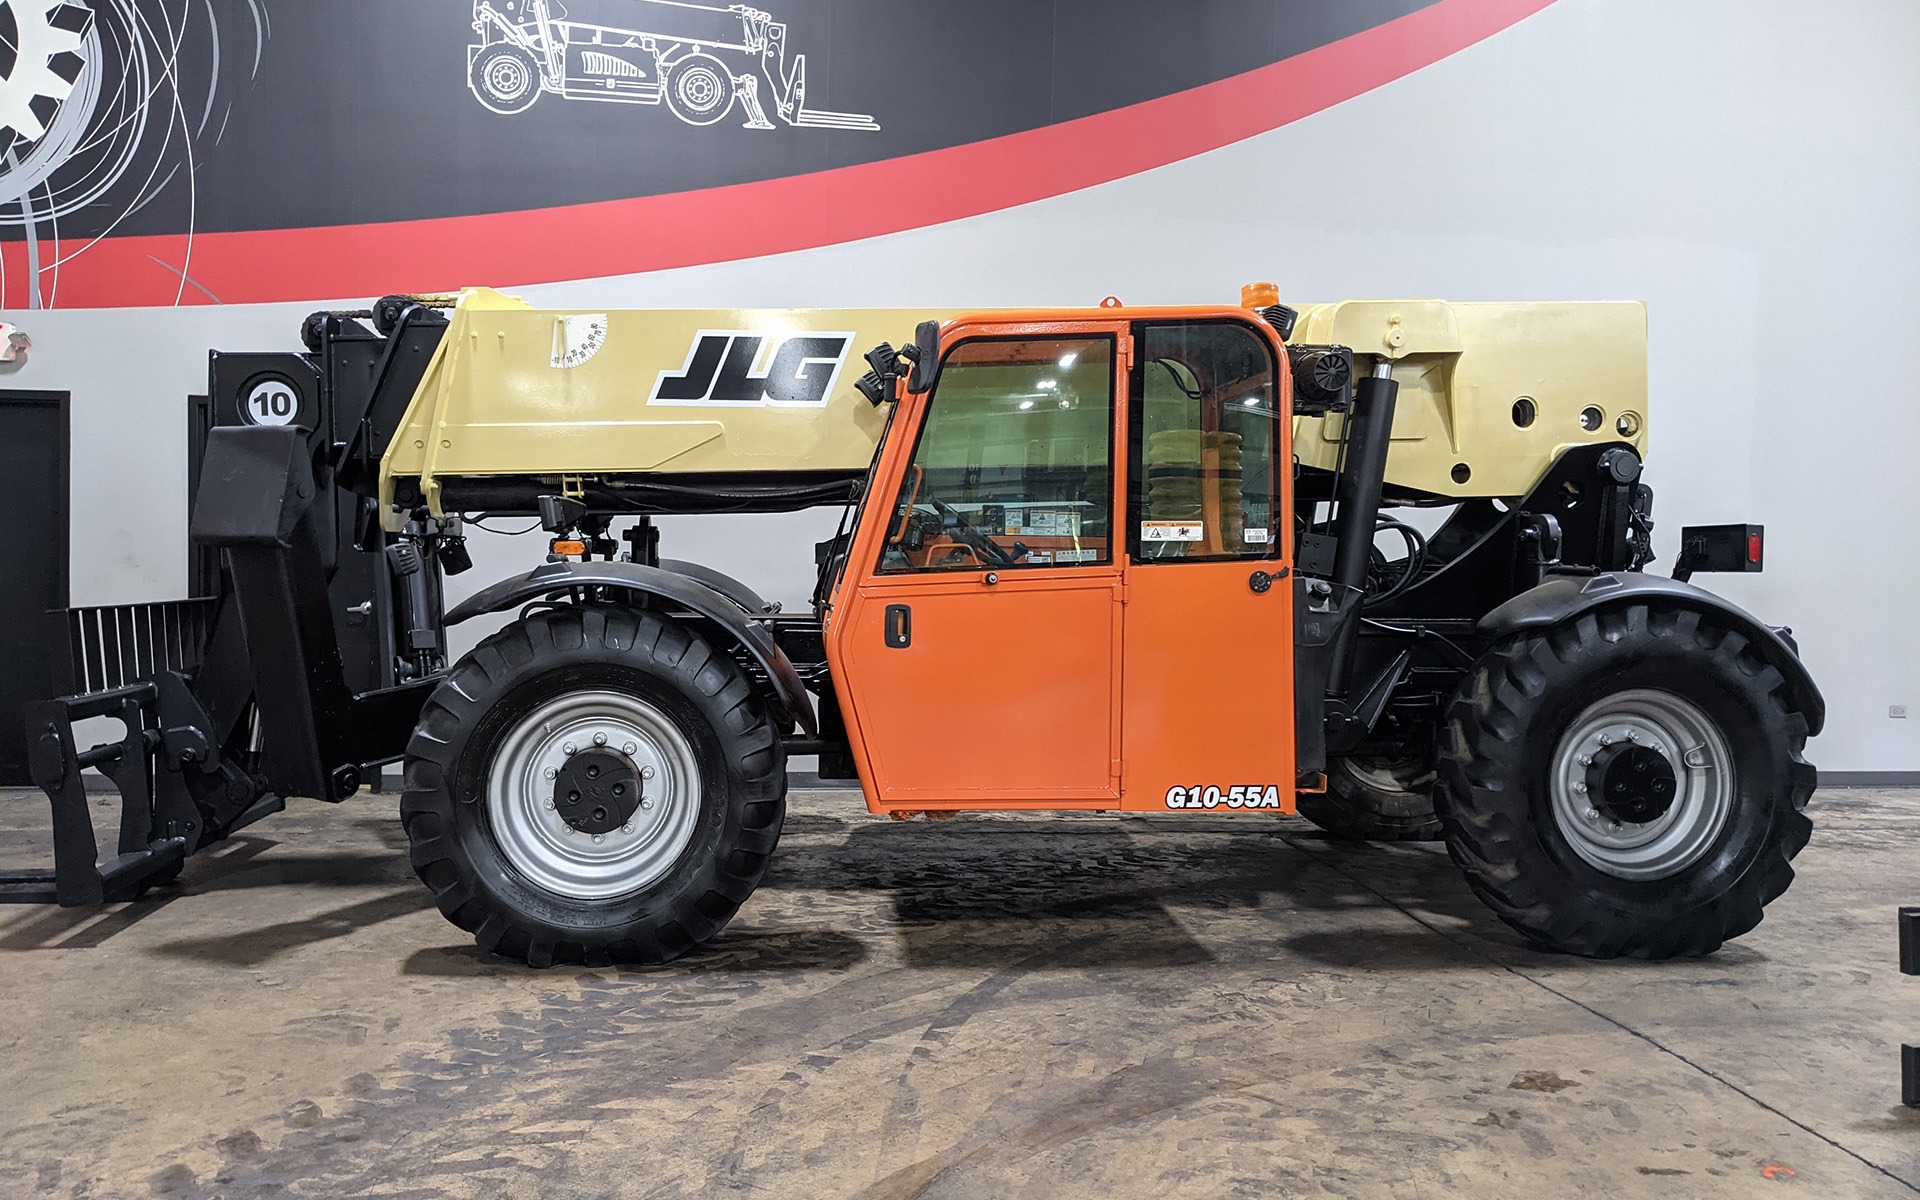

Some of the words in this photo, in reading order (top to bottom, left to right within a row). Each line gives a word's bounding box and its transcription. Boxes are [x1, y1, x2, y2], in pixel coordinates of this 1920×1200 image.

[571, 349, 578, 357] 20
[579, 350, 586, 358] 30
[655, 335, 848, 402] JLG
[253, 391, 291, 417] 10
[1165, 785, 1280, 809] G10-55A
